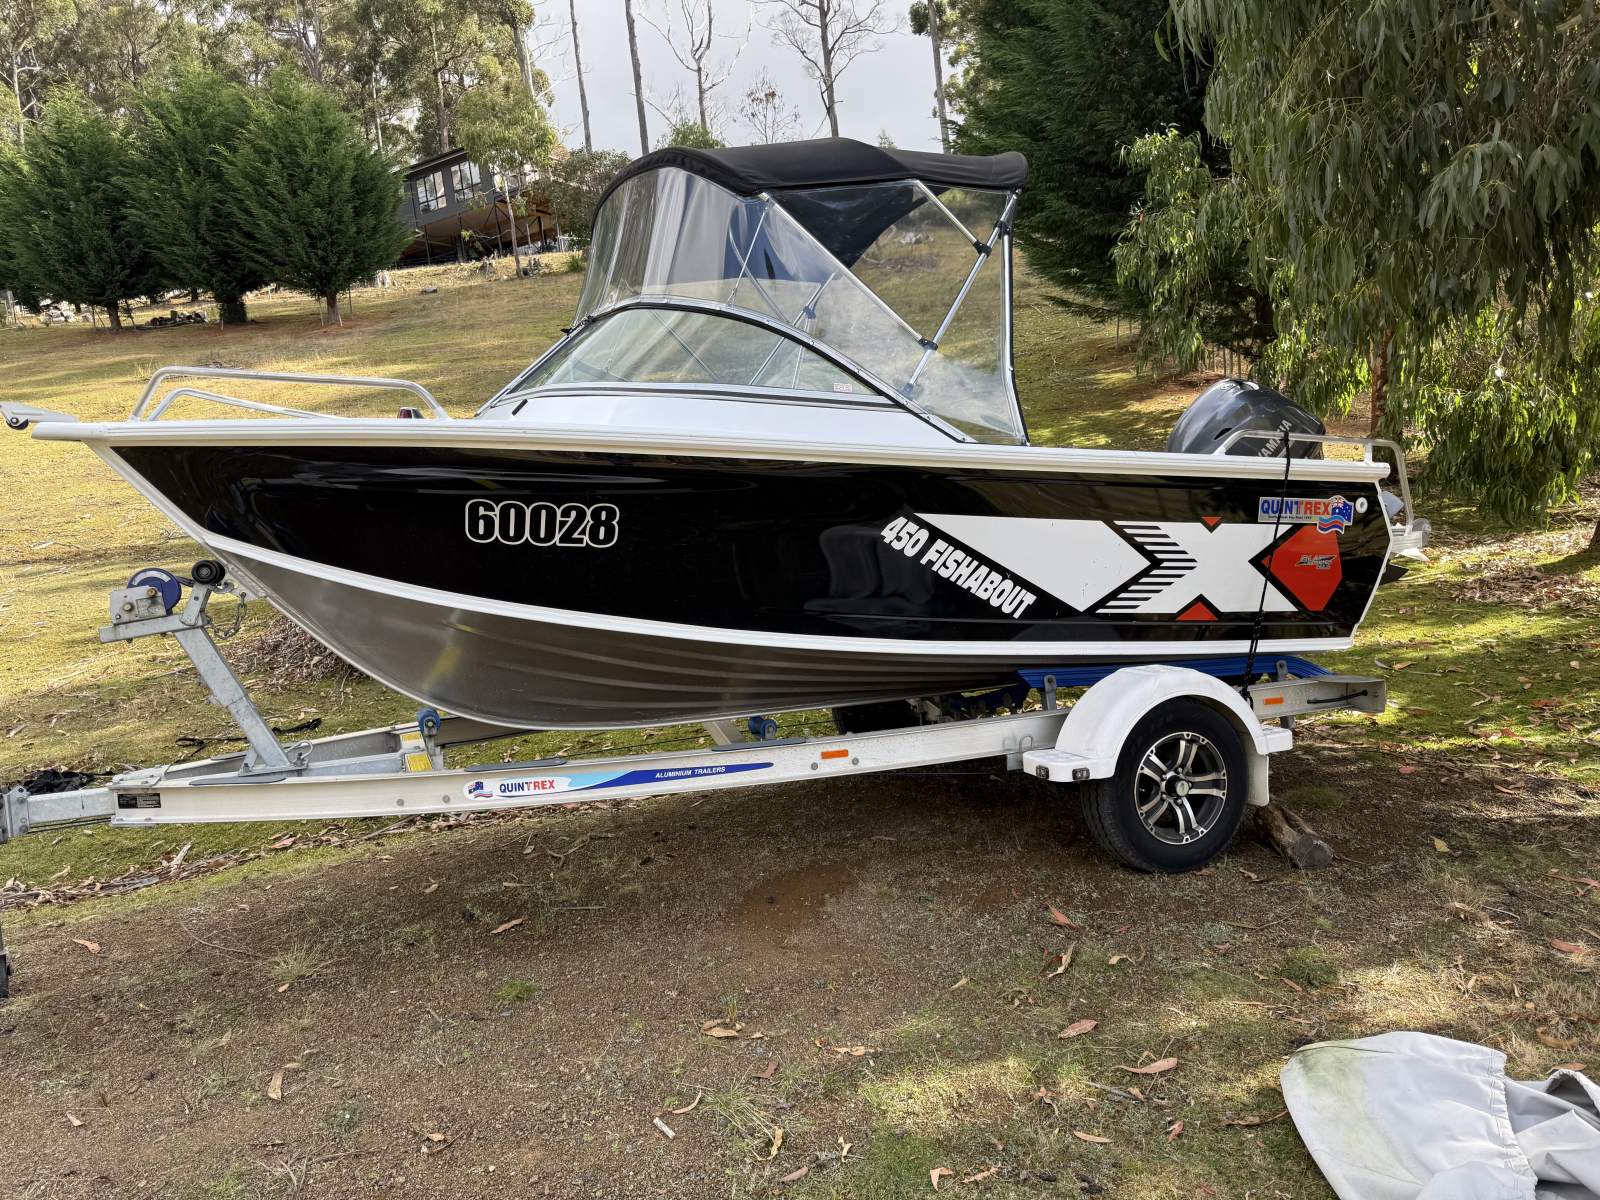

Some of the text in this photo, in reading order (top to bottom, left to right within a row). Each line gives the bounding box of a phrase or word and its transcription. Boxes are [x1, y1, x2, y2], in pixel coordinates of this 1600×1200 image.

[1258, 420, 1292, 457] AMHA
[465, 499, 619, 547] 60028
[881, 516, 1037, 619] 450 FISHABOUT
[499, 779, 555, 794] QUINTREX
[655, 766, 726, 778] ALUMINIUM TRAILERS
